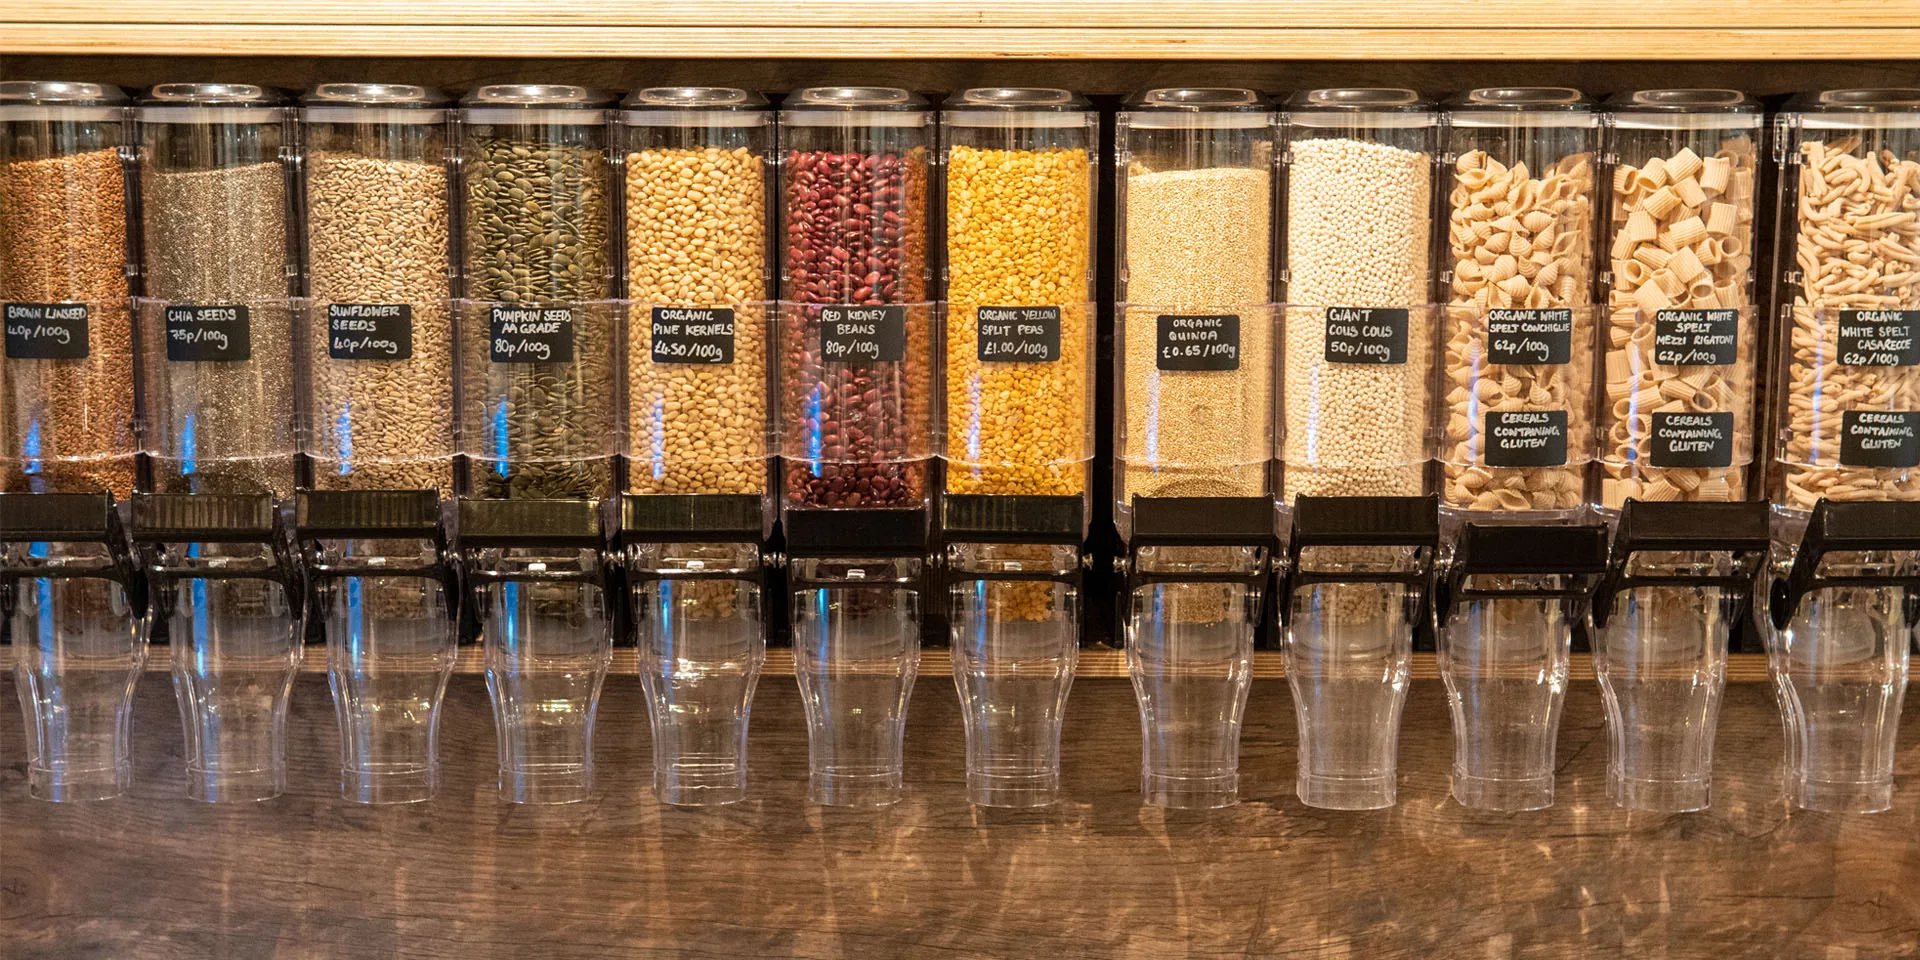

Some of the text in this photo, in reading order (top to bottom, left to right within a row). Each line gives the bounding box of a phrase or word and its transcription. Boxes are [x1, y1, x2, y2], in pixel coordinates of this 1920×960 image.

[8, 306, 41, 319] BROWN
[168, 309, 237, 322] CHIA SEEDS
[329, 305, 400, 317] SUNFLOWER
[493, 308, 572, 323] PUMPKIN SEEDS
[660, 309, 714, 321] ORGANIC
[822, 309, 886, 322] RED KIDNEY
[979, 309, 1056, 320] ORGANIC YELLOW
[1489, 310, 1569, 321] ORGANIC WHITE
[1657, 310, 1733, 322] ORGANIC WHITE
[1856, 310, 1903, 322] ORGANIC
[332, 320, 377, 332] SEEDS
[501, 322, 562, 334] AA GRADE
[836, 324, 876, 334] BEANS
[1173, 318, 1222, 328] ORGANIC
[1489, 322, 1570, 333] SPELT CONCHIGLIE
[1675, 322, 1712, 334] SPELT
[8, 324, 71, 344] 40p/100g
[653, 323, 734, 336] PINE KERNELS
[981, 324, 1044, 336] SPLIT PEAS
[1168, 330, 1218, 341] QUINOA
[1329, 324, 1393, 338] COUS COUS
[1841, 325, 1911, 337] WHITE SPELT
[169, 328, 228, 350] 75p/100g
[333, 336, 398, 354] 40p/100g
[1656, 334, 1734, 346] MEZZI RIGATONI
[1857, 338, 1912, 351] CASARECCE
[494, 338, 551, 360] 80p/100g
[825, 339, 879, 359] 80p/100g
[984, 340, 1048, 358] £1.00/100g
[1162, 343, 1236, 358] £0.65/100g
[1330, 341, 1391, 362] 50p/100g
[1494, 337, 1550, 362] 62p/100g
[1658, 348, 1716, 367] 62p/100g
[1843, 351, 1899, 367] 62p/100g
[1501, 412, 1550, 424] CEREALS
[1665, 415, 1713, 426] CEREALS
[1859, 413, 1905, 424] CEREALS
[1494, 425, 1560, 437] CONTAINING
[1659, 428, 1723, 439] CONTAINING
[1850, 424, 1914, 437] CONTAINING
[1500, 436, 1547, 449] GLUTEN
[1669, 440, 1715, 453] GLUTEN
[1861, 438, 1902, 449] GLUTEN
